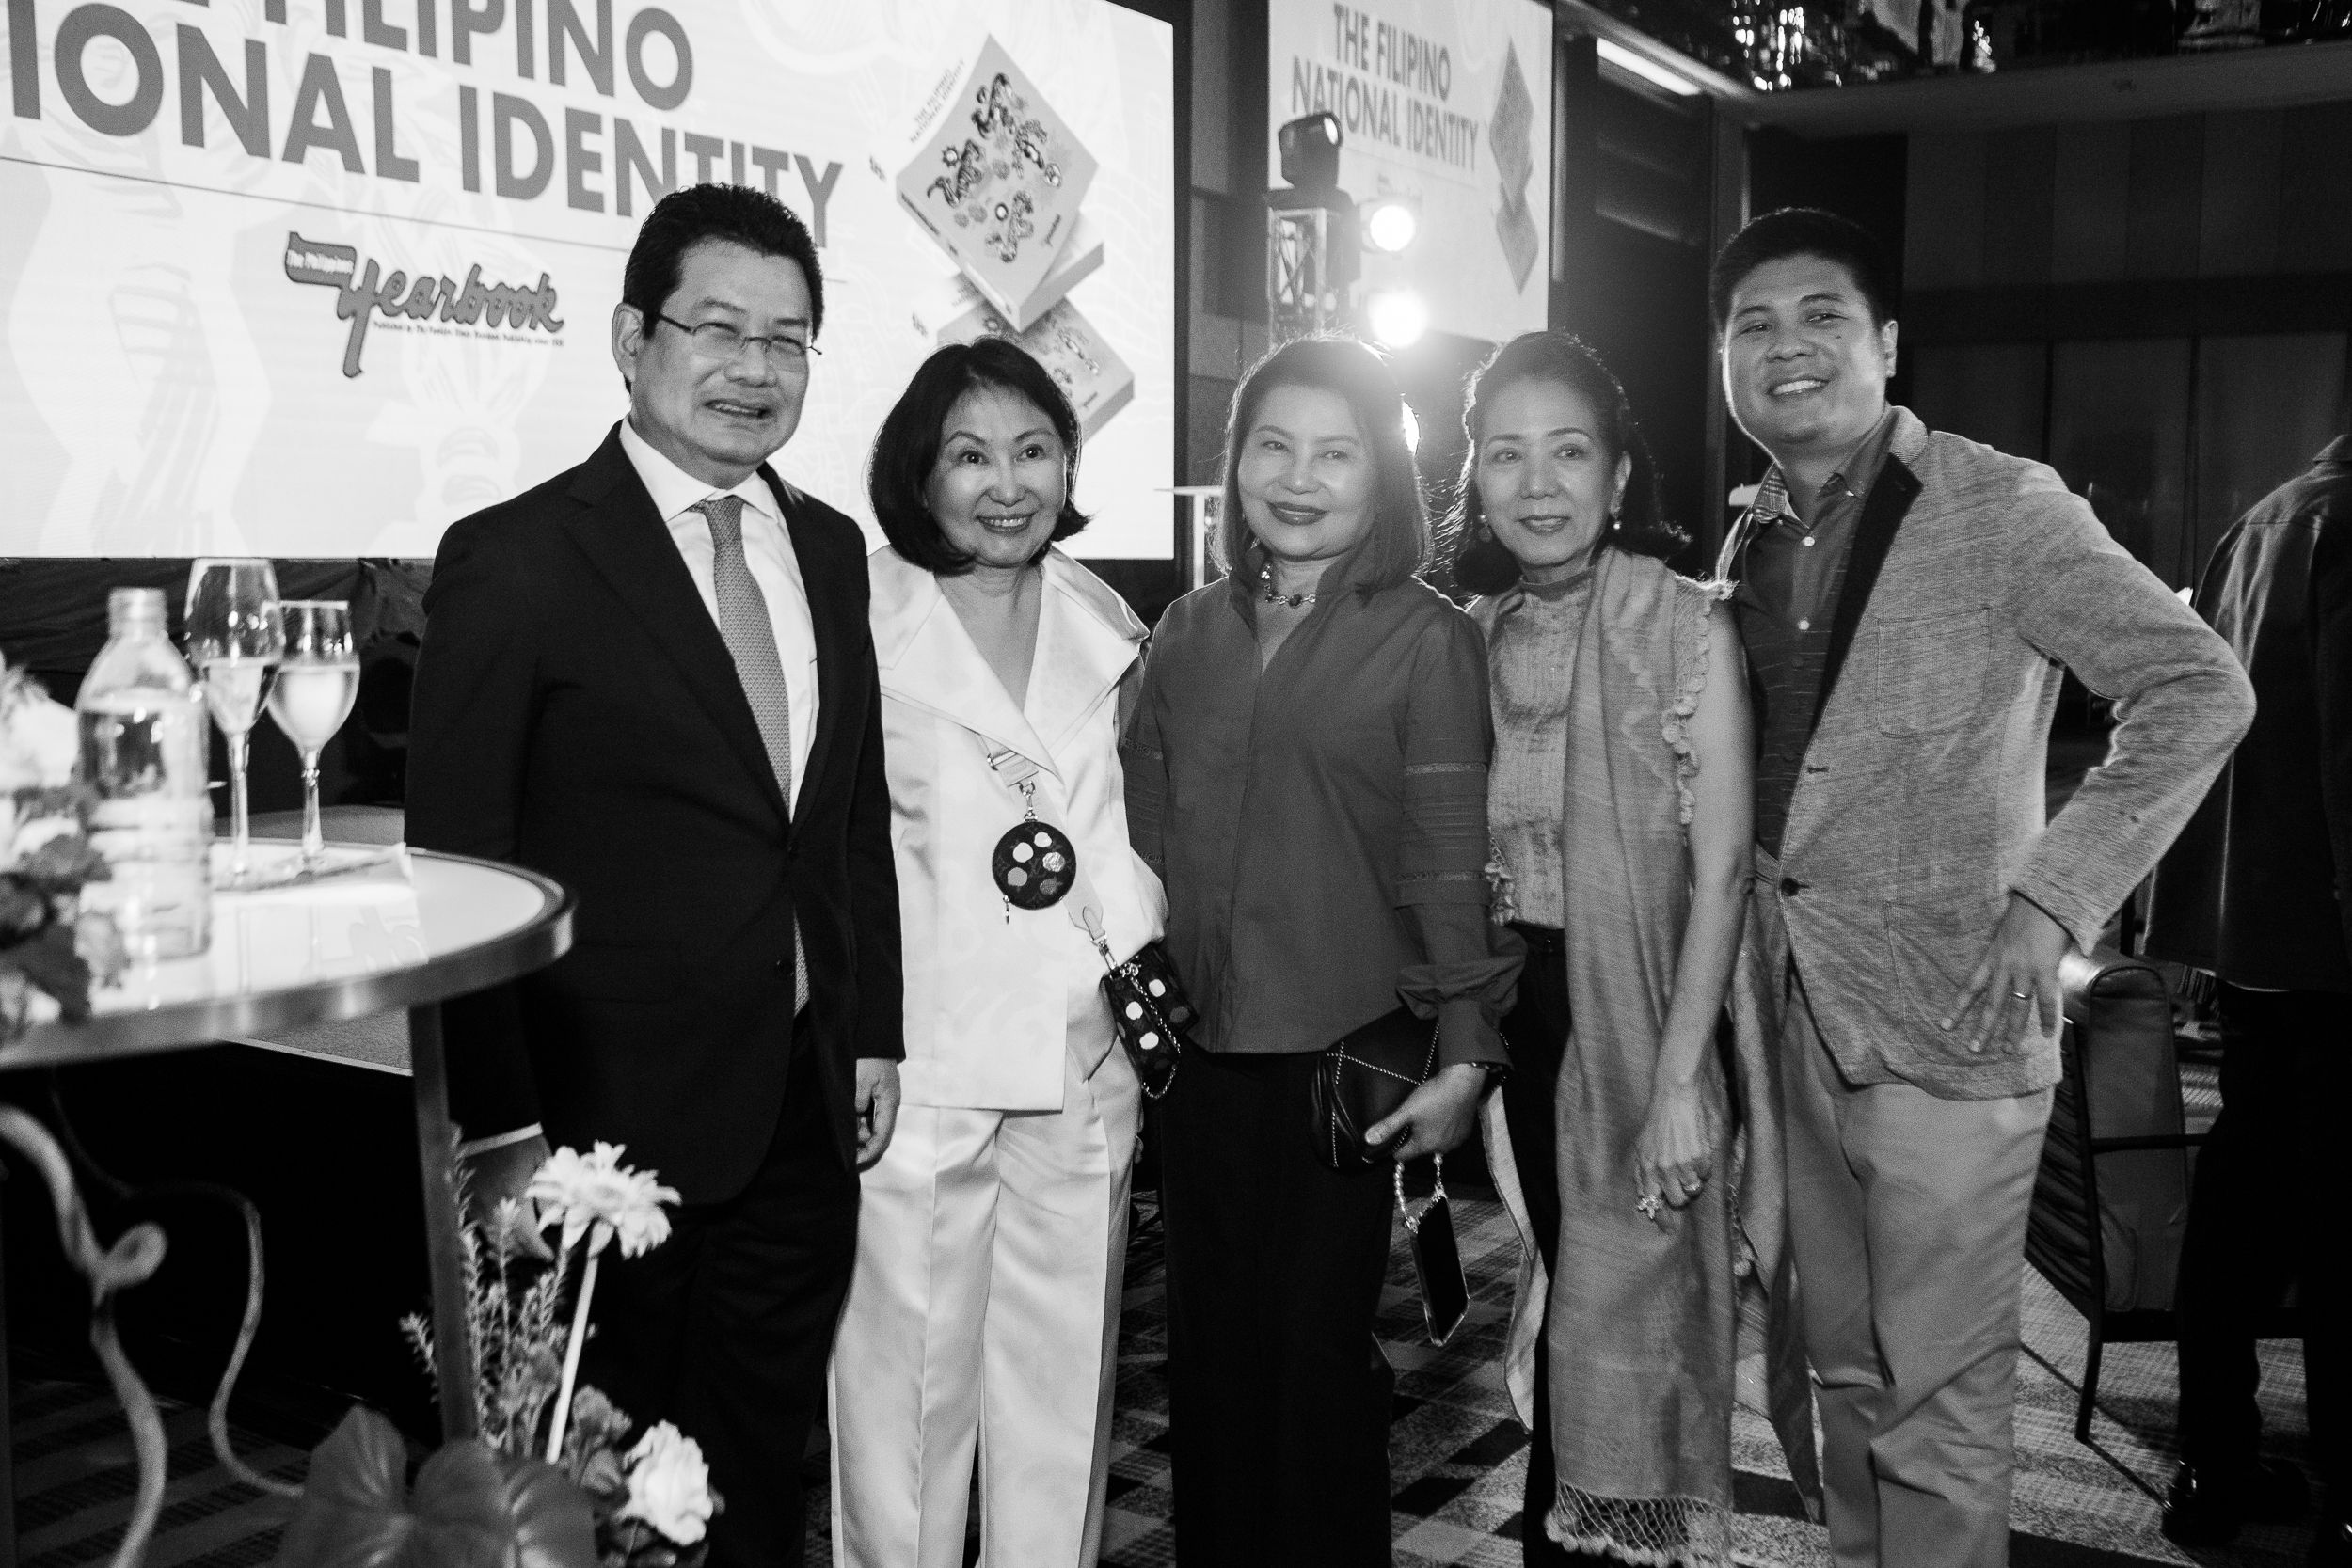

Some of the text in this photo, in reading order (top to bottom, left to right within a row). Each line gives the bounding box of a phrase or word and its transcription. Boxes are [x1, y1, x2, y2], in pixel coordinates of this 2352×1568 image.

[265, 0, 694, 111] LIPINO
[1333, 2, 1451, 102] THE FILIPINO
[1292, 55, 1478, 171] NATIONAL IDENTITY
